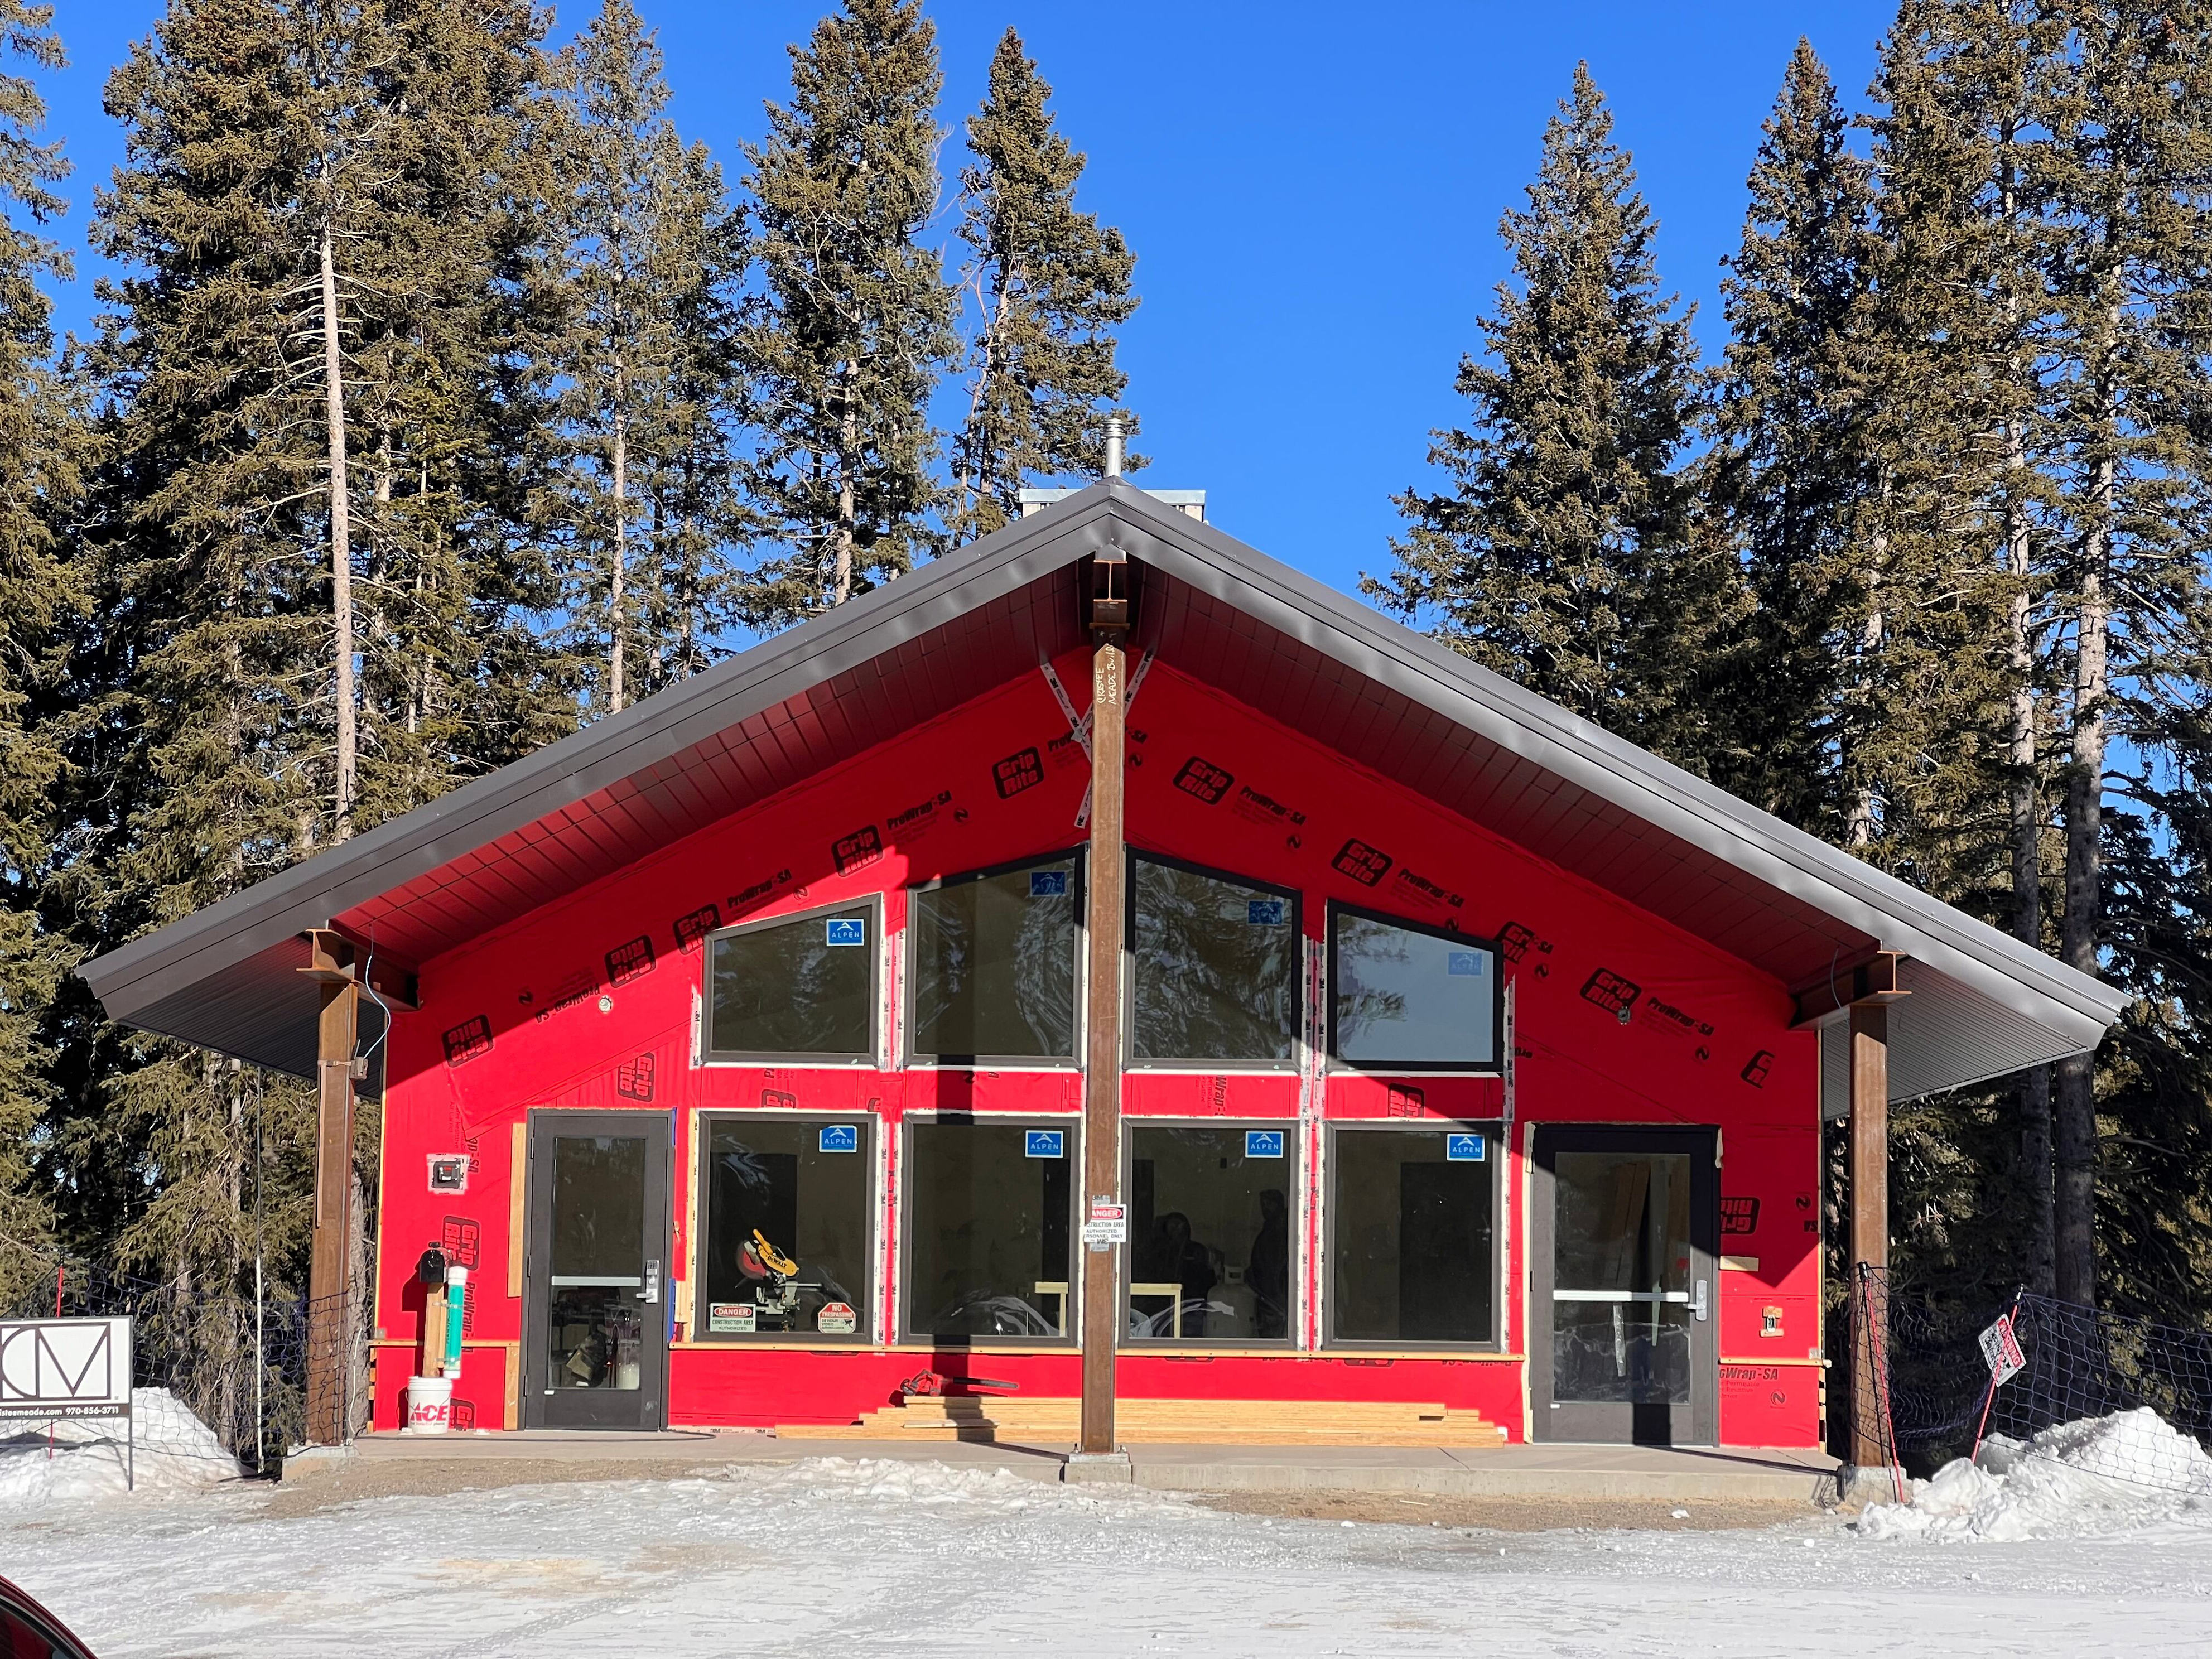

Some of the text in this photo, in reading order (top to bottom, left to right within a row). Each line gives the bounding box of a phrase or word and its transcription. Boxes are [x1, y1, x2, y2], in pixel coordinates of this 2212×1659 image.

[885, 956, 890, 966] 3M
[898, 974, 903, 984] 3M
[1306, 975, 1311, 985] 3M
[1319, 978, 1324, 988] 3M
[884, 1001, 889, 1012] 3M
[695, 1011, 700, 1021] 3M
[1507, 1015, 1512, 1025] 3M
[1306, 1019, 1311, 1030] 3M
[1319, 1024, 1324, 1034] 3M
[1507, 1059, 1512, 1070] 3M
[880, 1240, 885, 1250] 3M
[879, 1285, 884, 1295] 3M
[0, 1406, 119, 1416] isteemeade.com 970-856-3711
[410, 1402, 448, 1421] ACE
